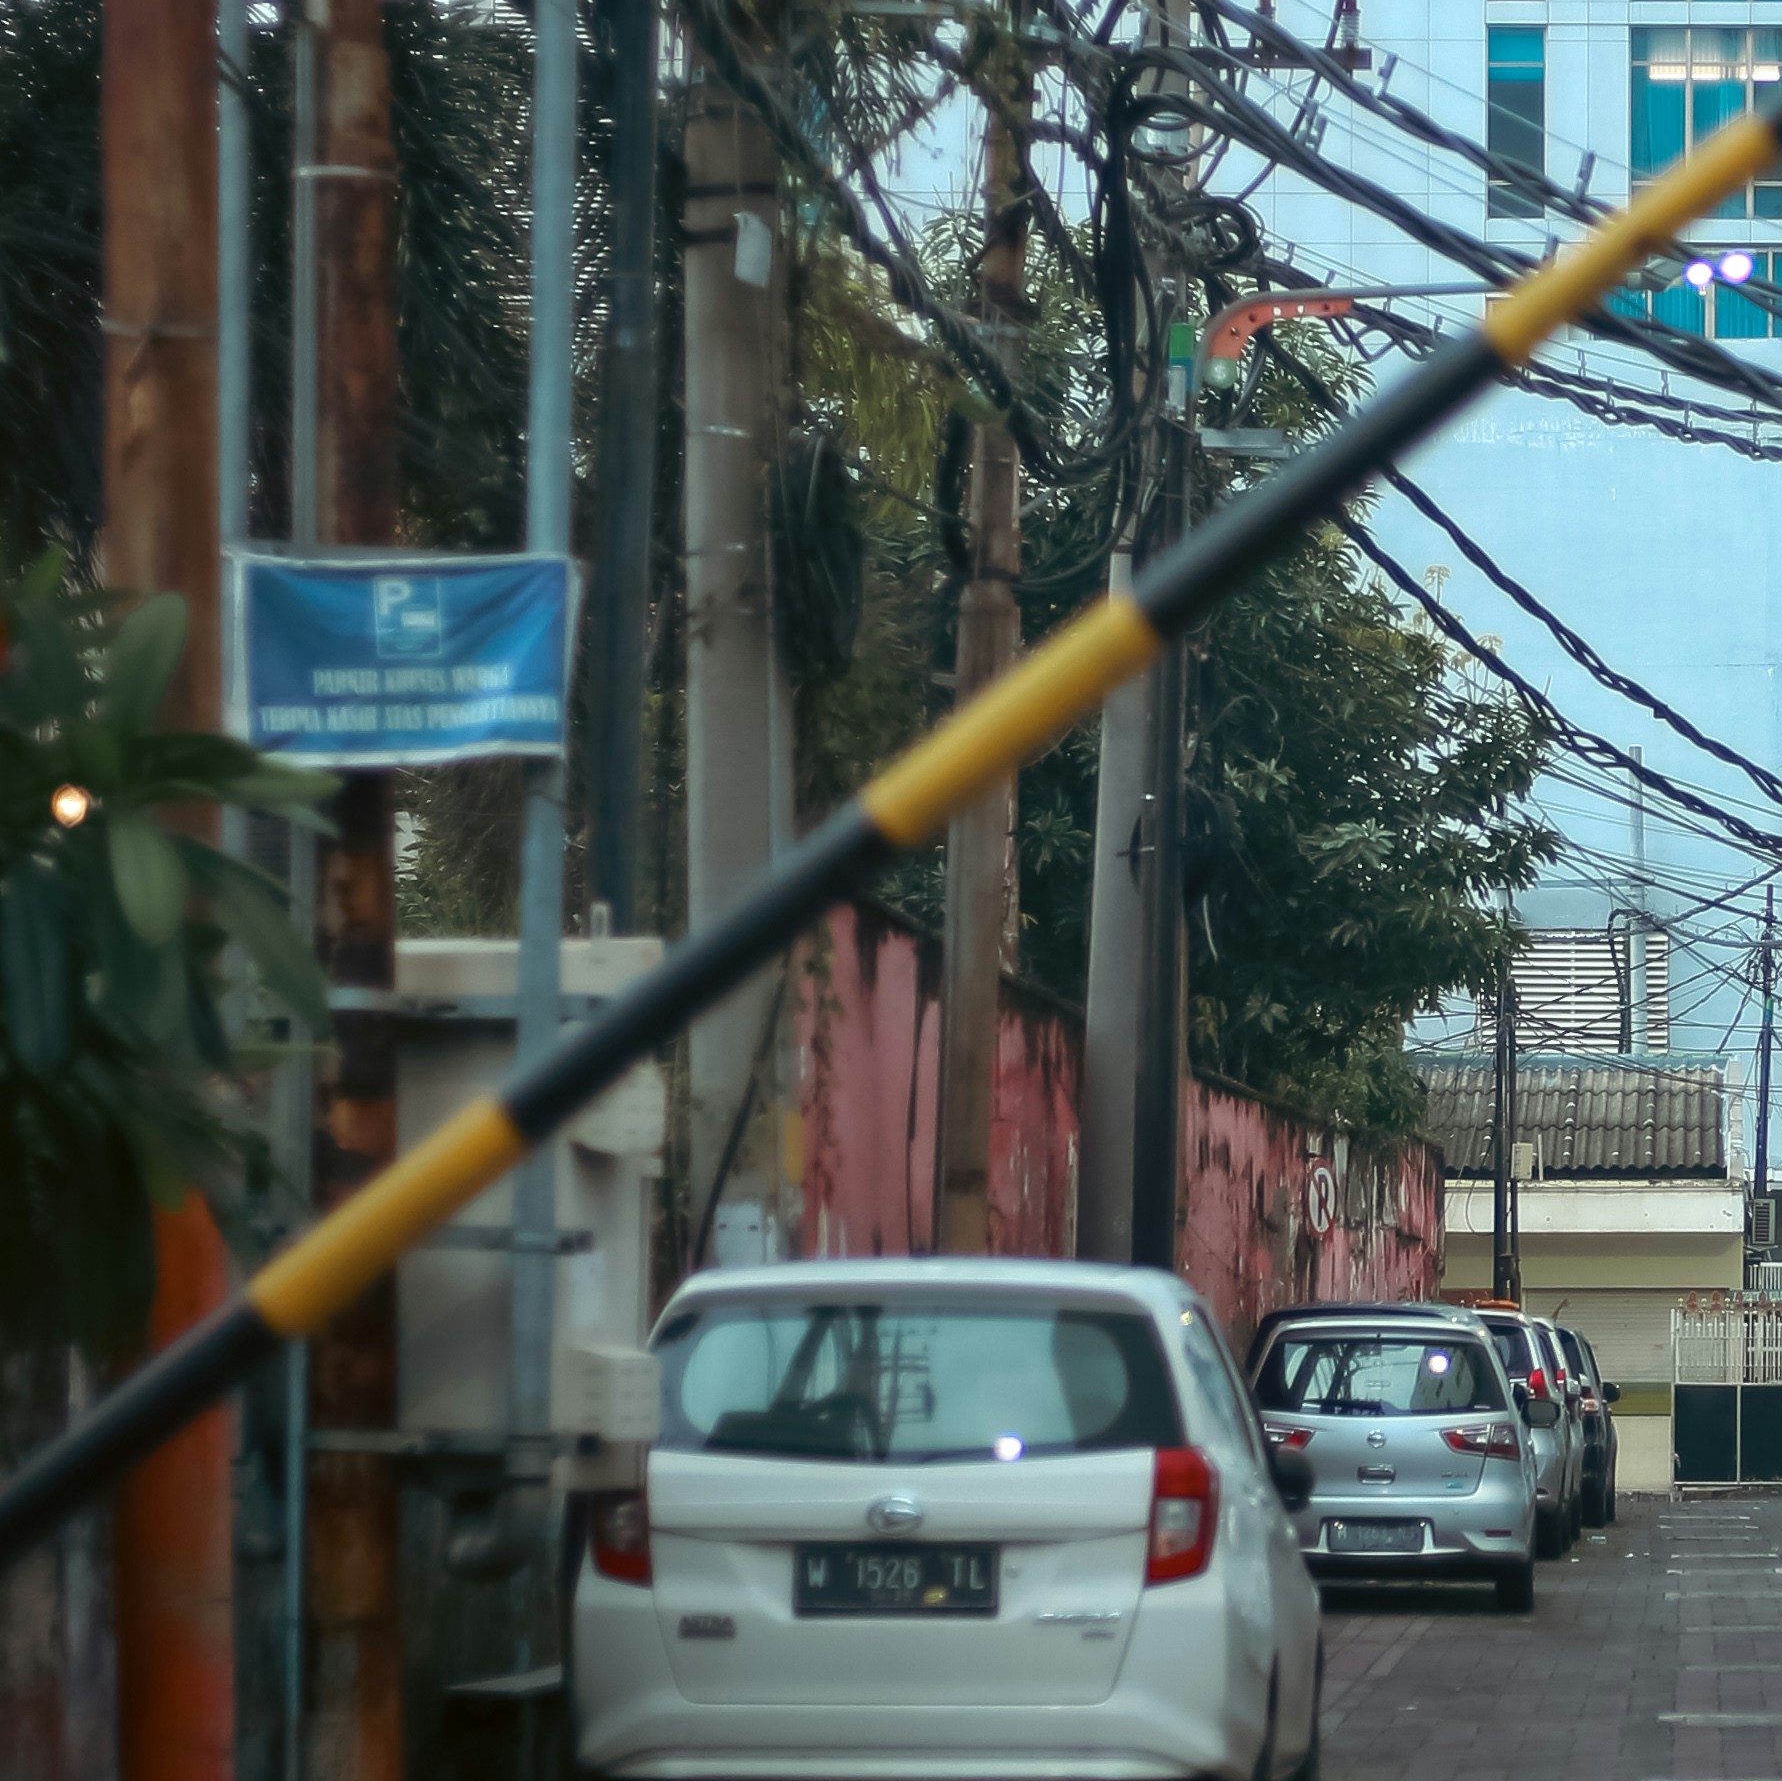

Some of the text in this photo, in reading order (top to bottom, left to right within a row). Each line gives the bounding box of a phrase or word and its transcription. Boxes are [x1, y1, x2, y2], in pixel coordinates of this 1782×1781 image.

[807, 1556, 986, 1591] W 1526 TL
